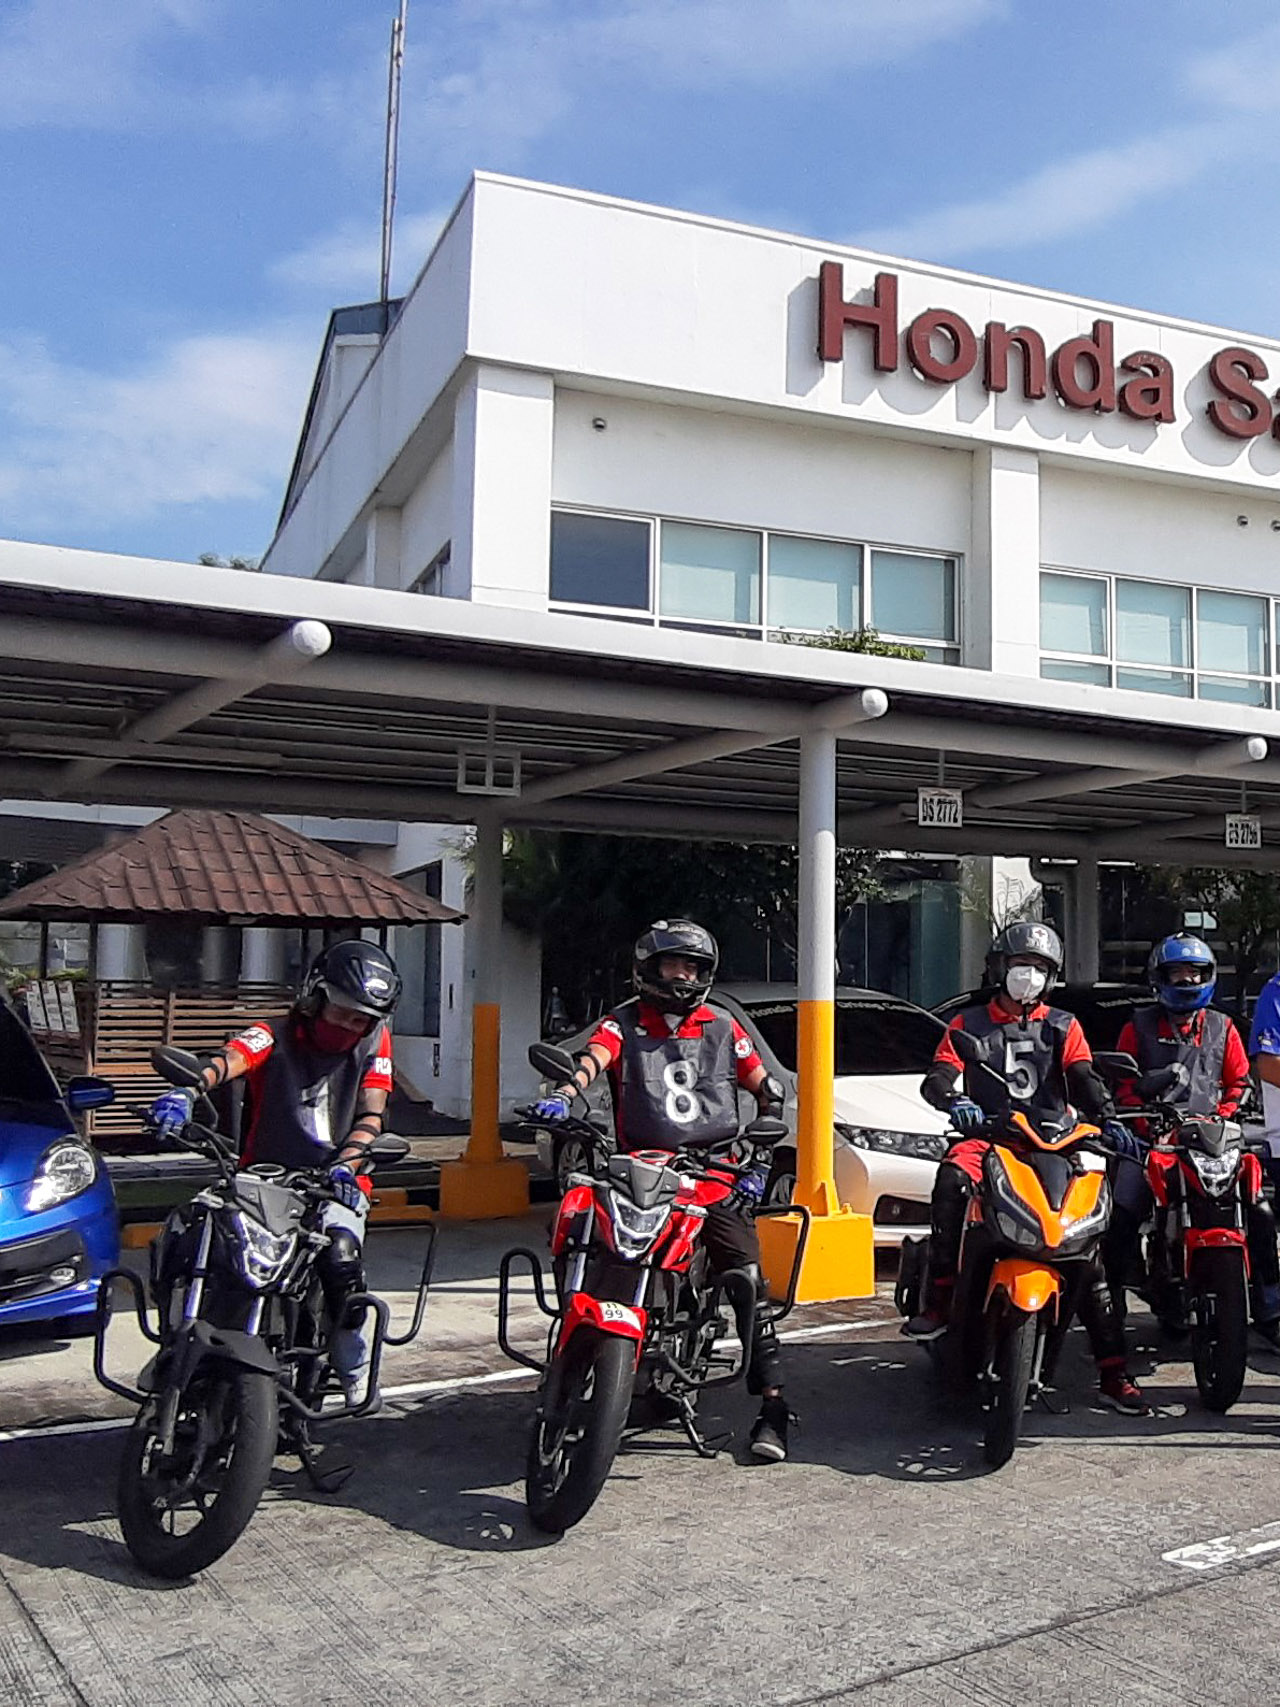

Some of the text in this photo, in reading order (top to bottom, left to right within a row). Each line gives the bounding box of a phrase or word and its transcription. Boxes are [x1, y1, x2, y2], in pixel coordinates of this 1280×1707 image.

[819, 260, 1177, 424] Honda
[663, 1060, 700, 1123] 8
[1005, 1040, 1038, 1099] 5
